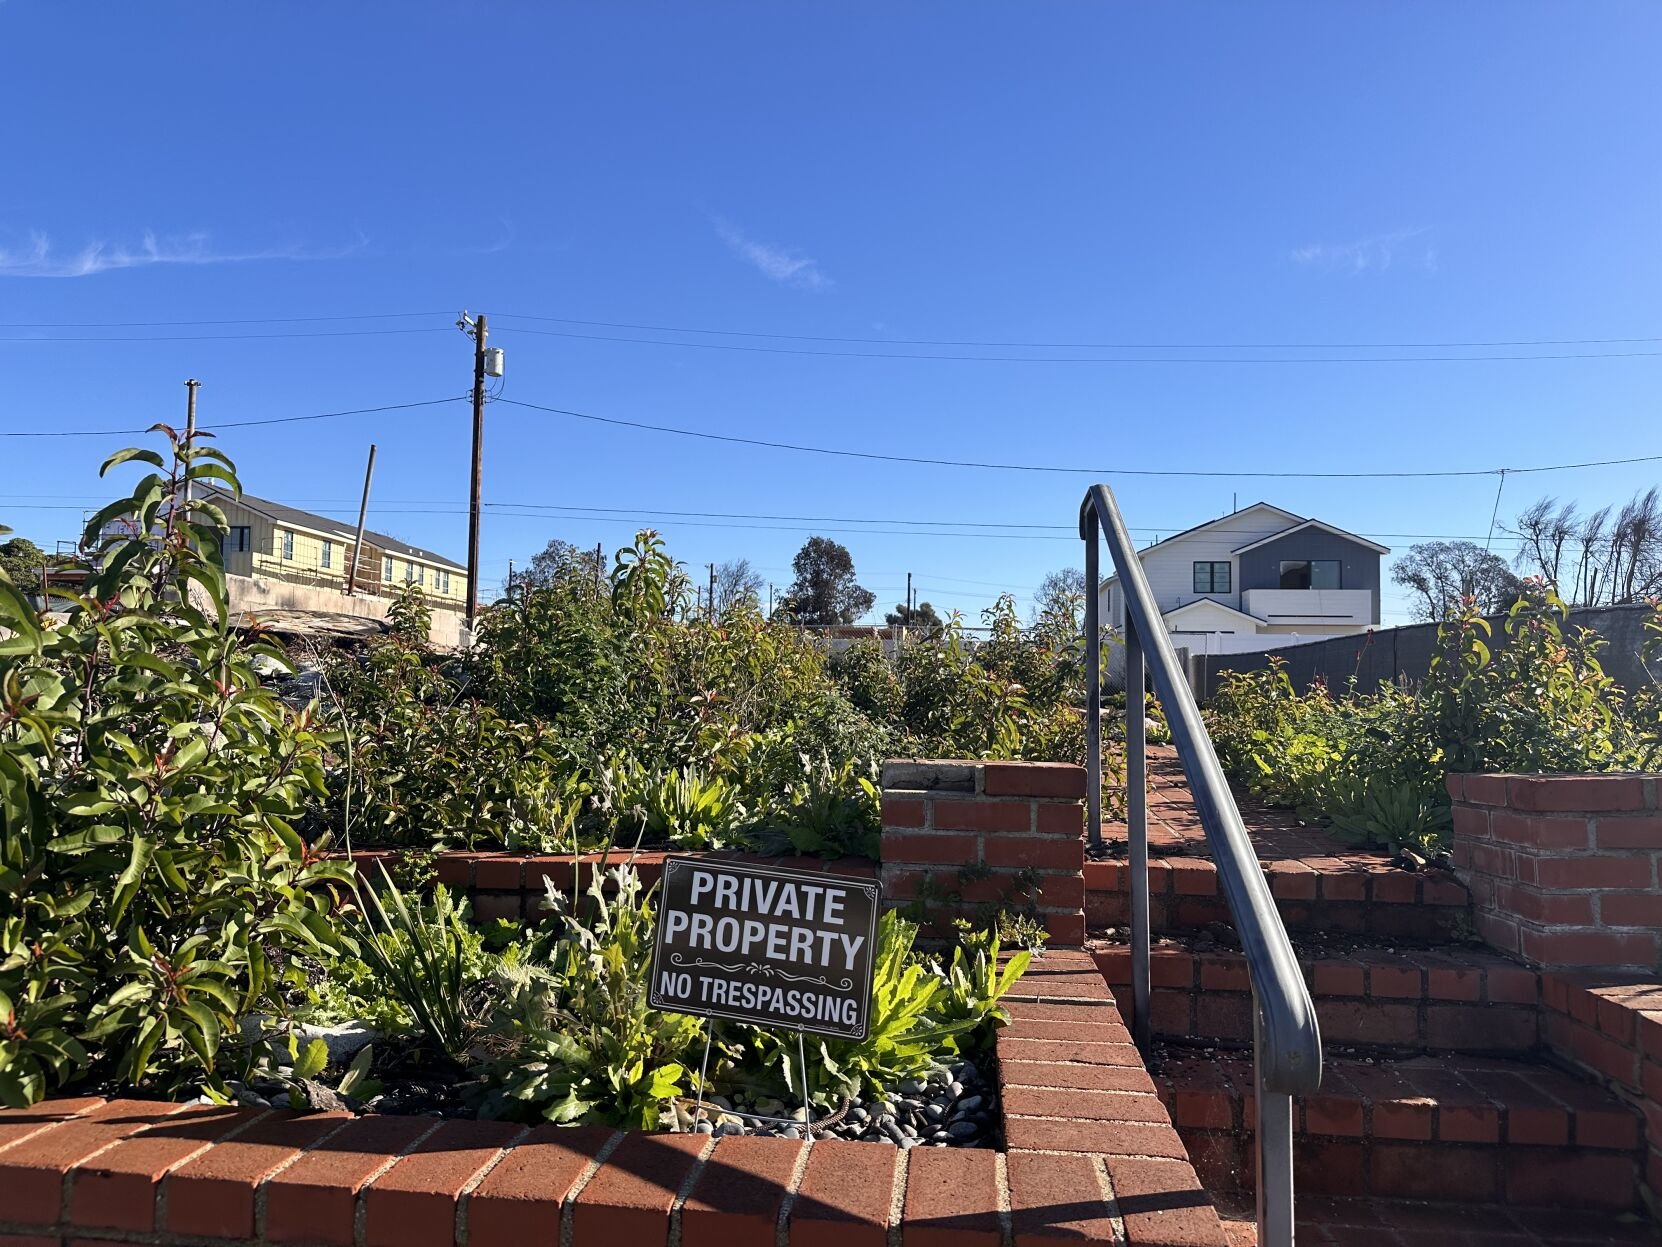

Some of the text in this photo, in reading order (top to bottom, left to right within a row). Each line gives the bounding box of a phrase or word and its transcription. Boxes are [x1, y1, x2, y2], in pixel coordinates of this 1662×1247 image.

[690, 871, 846, 925] PRIVATE
[665, 909, 865, 971] PROPERTY
[660, 971, 857, 1026] NO TRESPASSING
